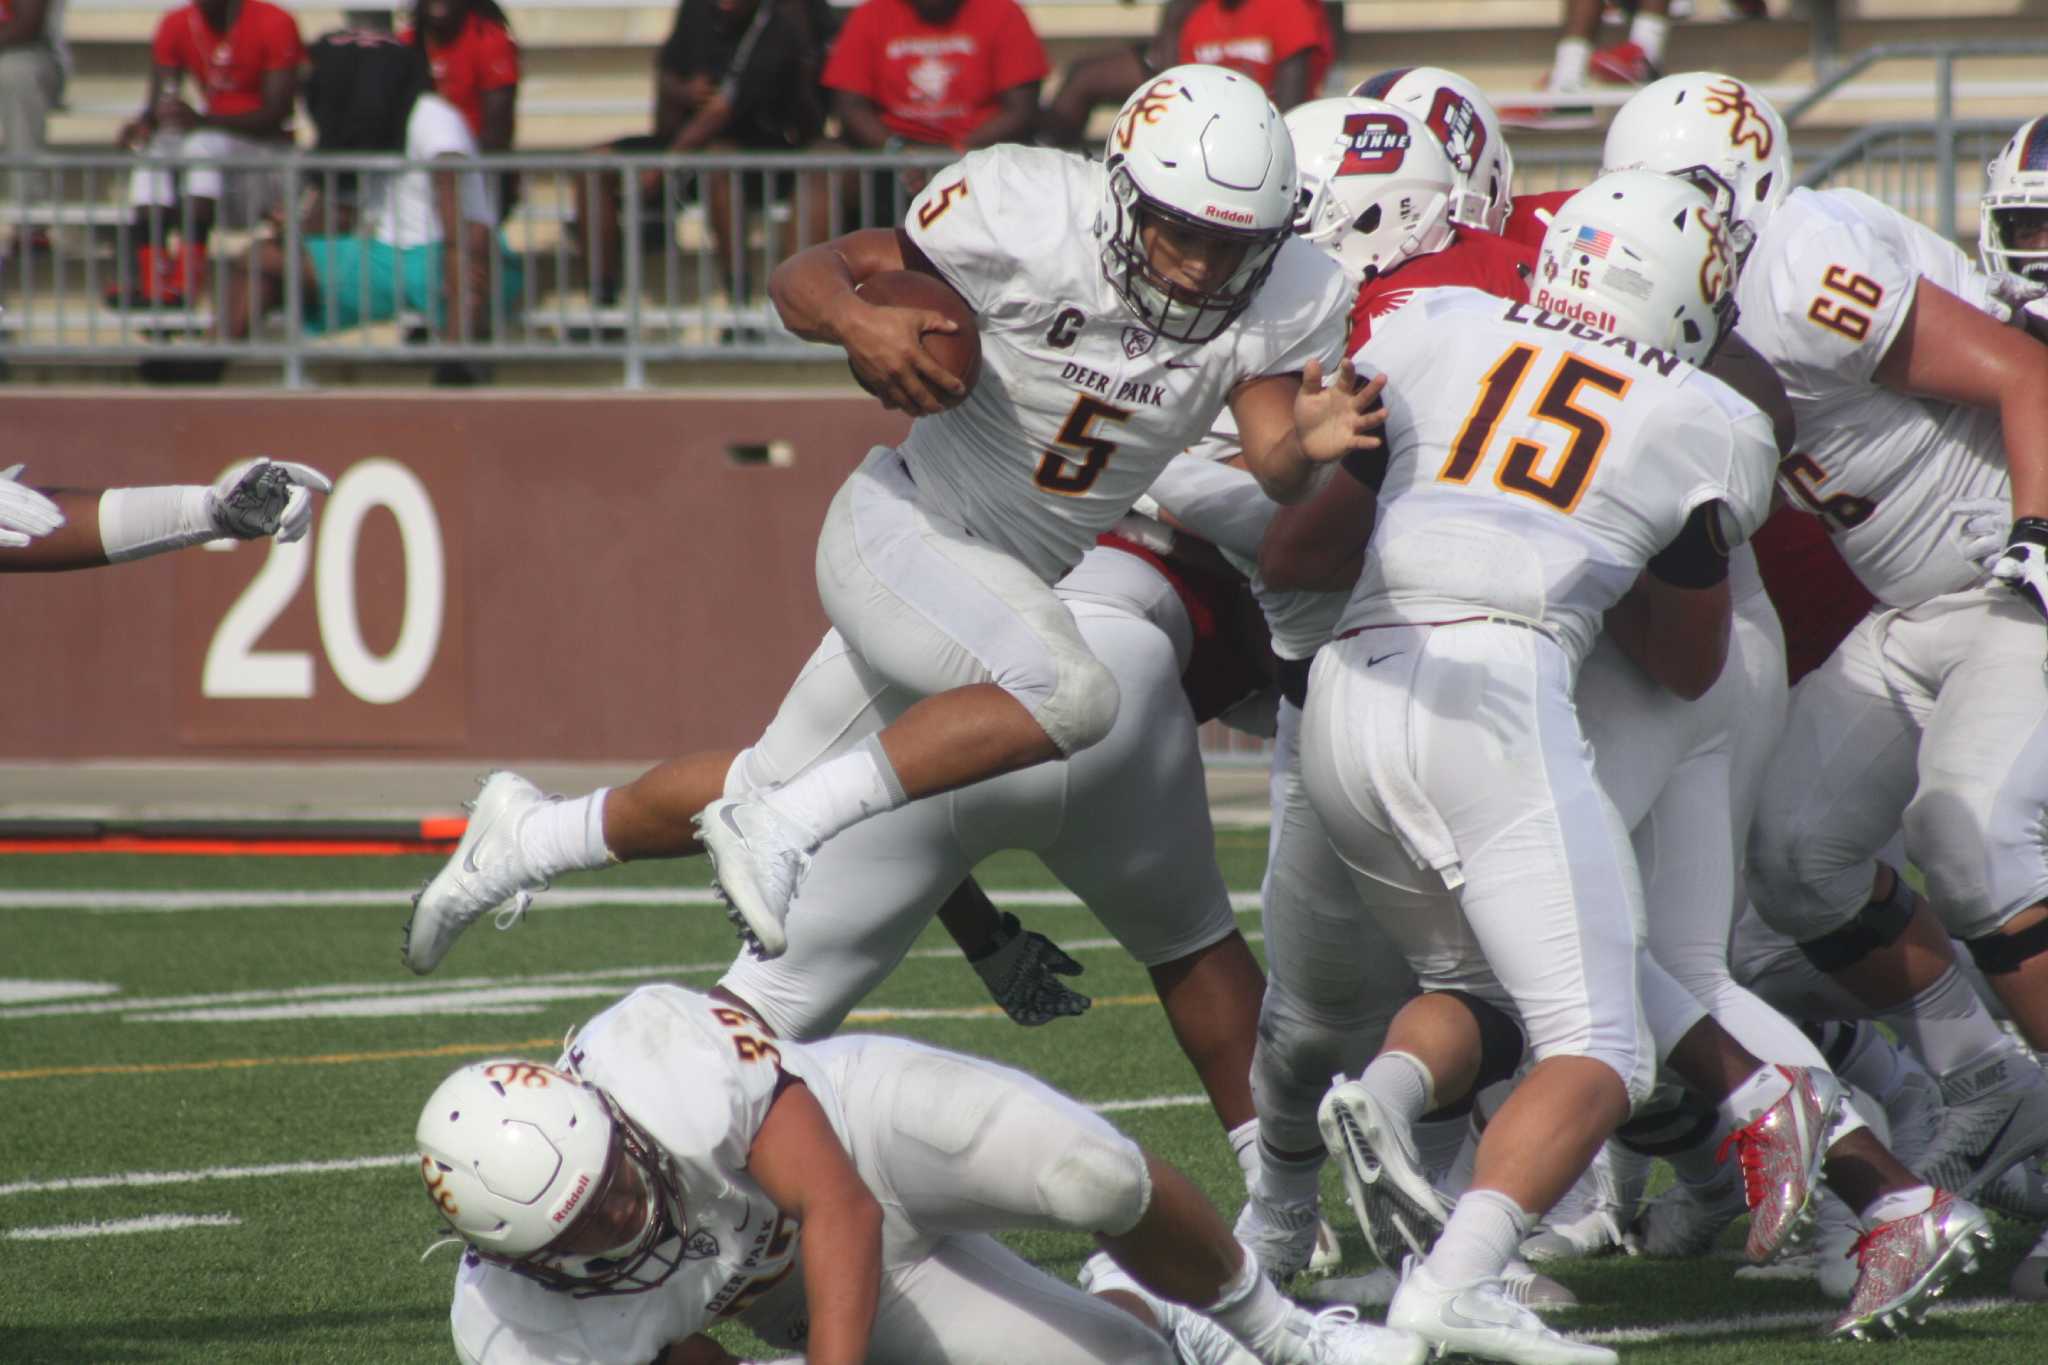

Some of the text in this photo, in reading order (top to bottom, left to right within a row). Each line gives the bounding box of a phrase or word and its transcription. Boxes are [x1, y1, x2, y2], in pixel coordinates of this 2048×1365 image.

[916, 176, 969, 229] 5
[1204, 204, 1255, 225] Riddell
[1570, 267, 1591, 289] 15
[1806, 263, 1886, 343] 66
[1046, 307, 1086, 349] C
[1536, 288, 1617, 334] Riddell
[1502, 302, 1682, 378] LOGAN
[1060, 362, 1167, 408] DEER PARK
[1033, 391, 1136, 497] 5
[1434, 340, 1635, 516] 15
[202, 457, 446, 705] 20
[552, 1174, 590, 1223] Riddell
[704, 1275, 748, 1313] DEER
[743, 1219, 774, 1268] PARK
